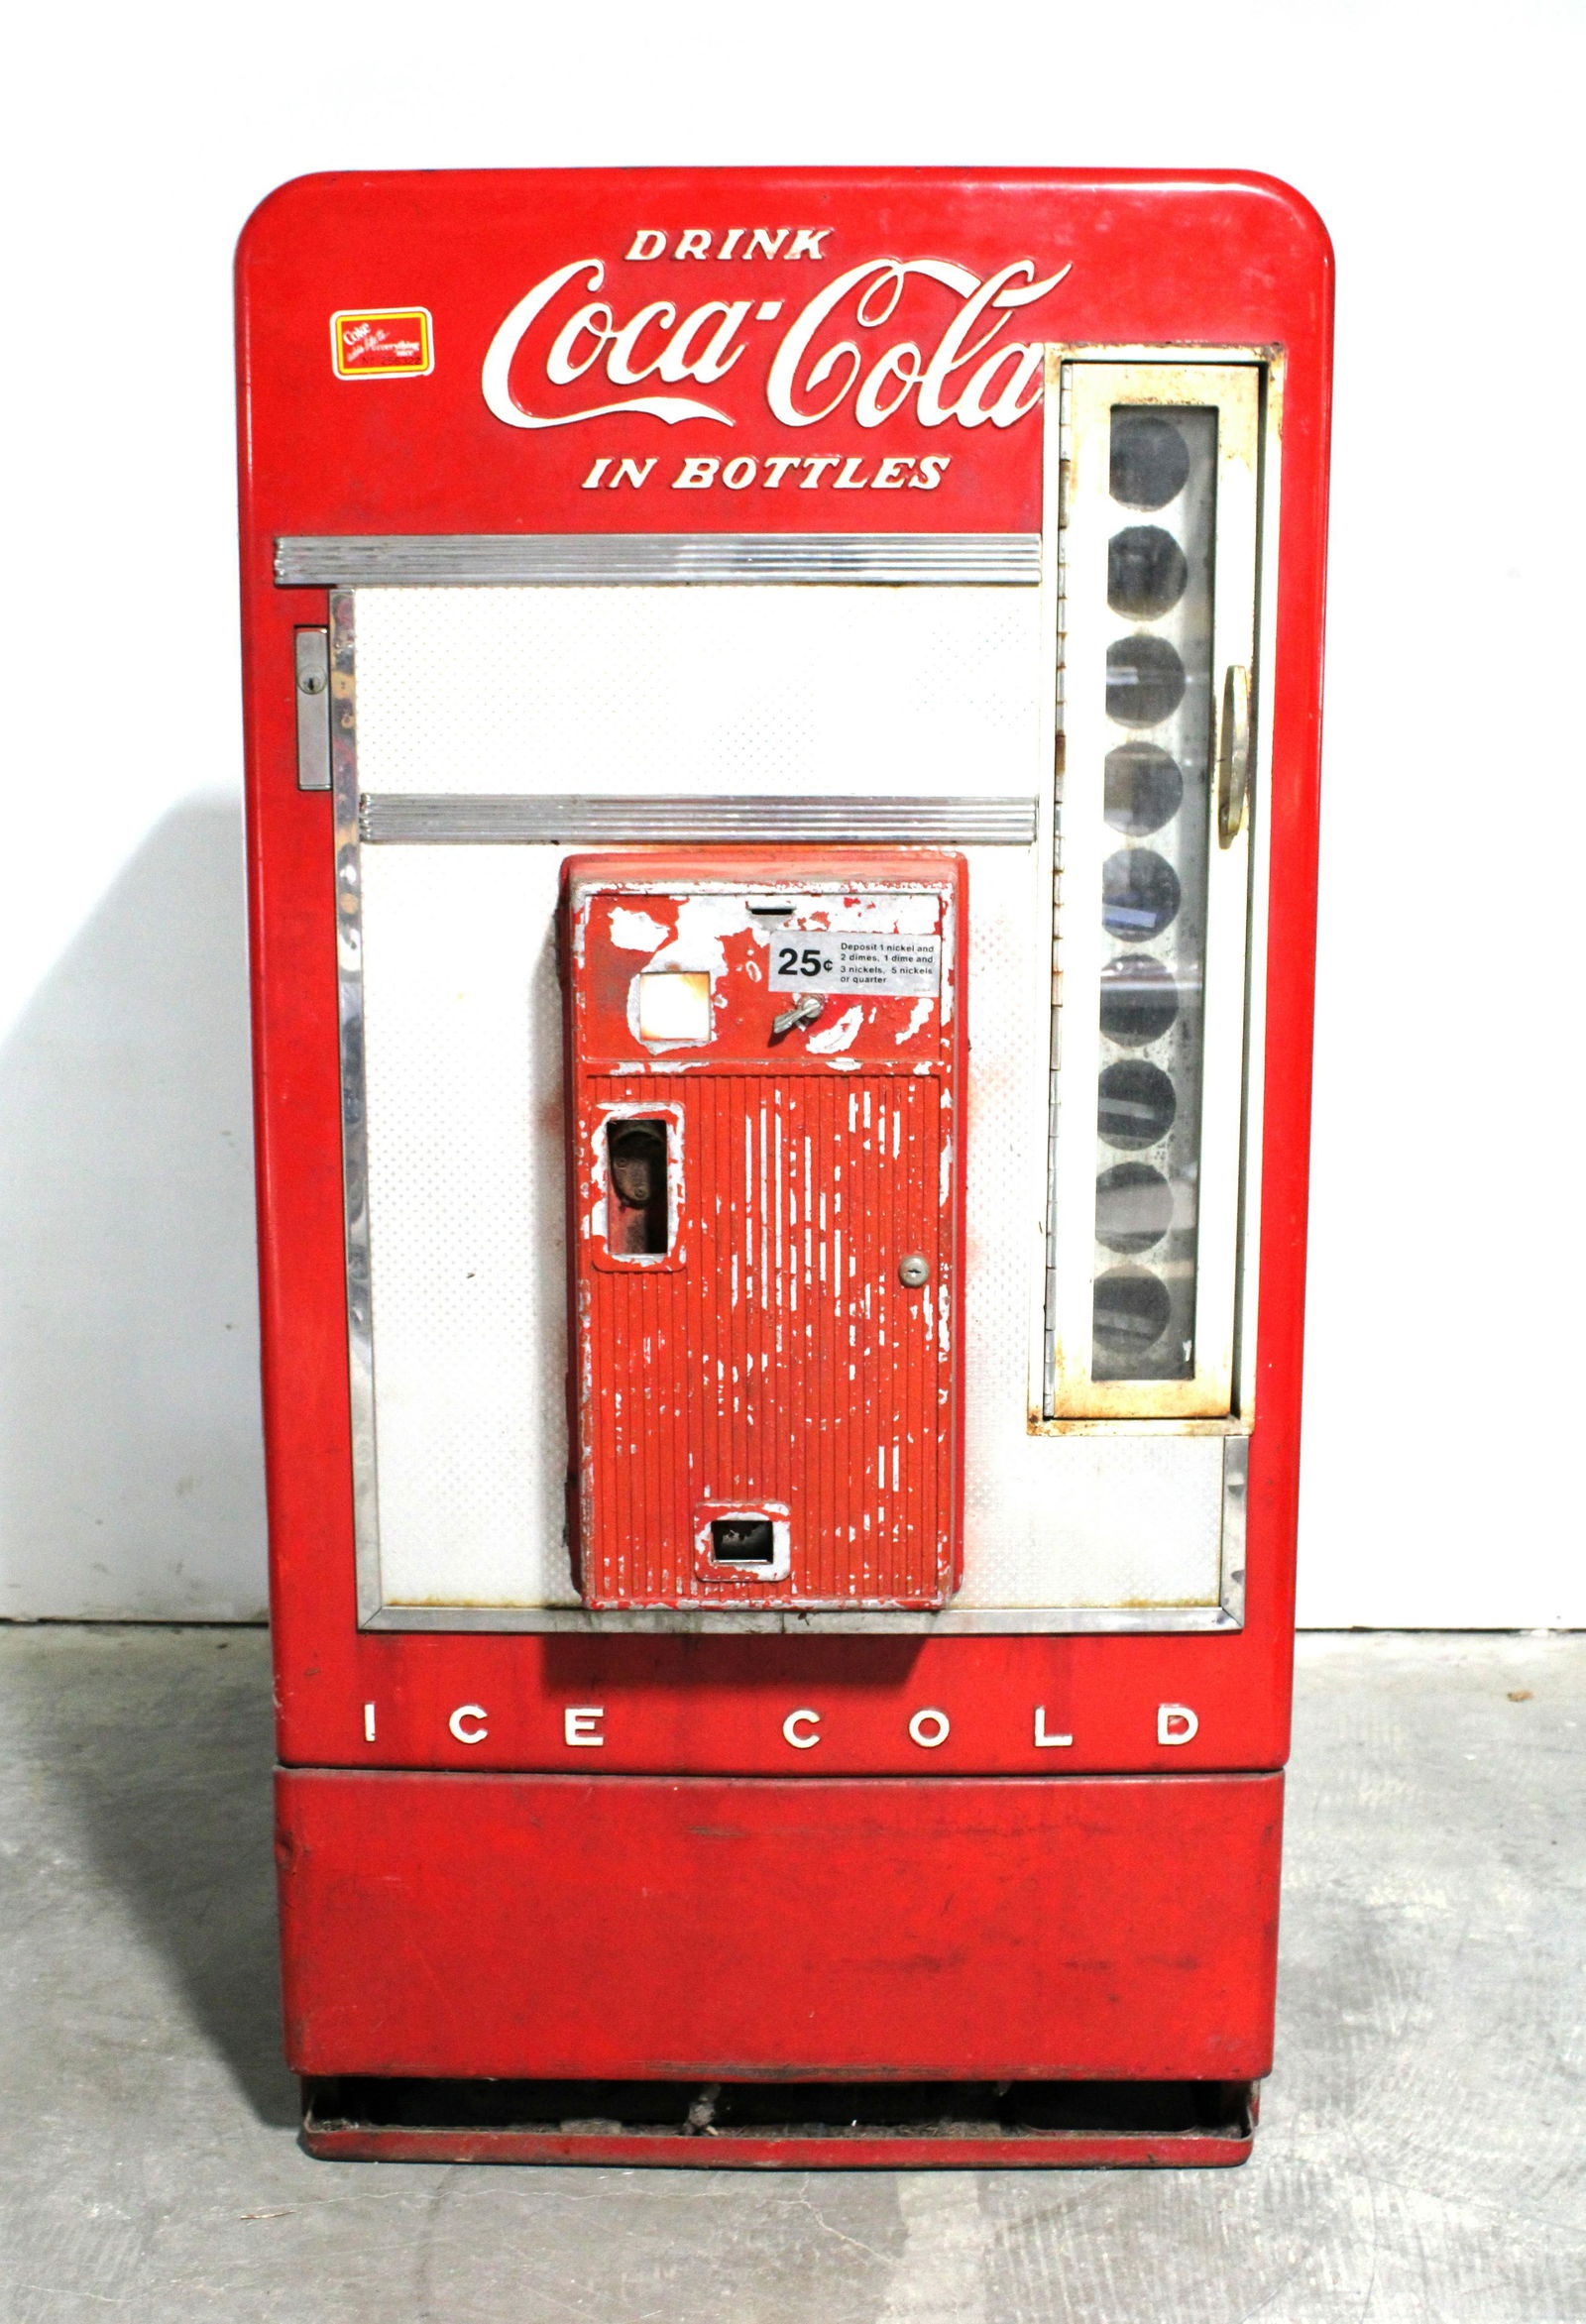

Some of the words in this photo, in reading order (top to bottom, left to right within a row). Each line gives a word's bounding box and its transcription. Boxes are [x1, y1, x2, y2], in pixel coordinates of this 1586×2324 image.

[624, 228, 832, 261] DRINK
[482, 257, 1073, 429] Coca-Cola
[581, 457, 659, 490] IN
[671, 456, 952, 490] BOTTLES
[777, 947, 834, 977] 25¢
[841, 942, 877, 951] Deposit
[364, 1704, 604, 1746] ICE
[782, 1703, 1199, 1748] COLD
